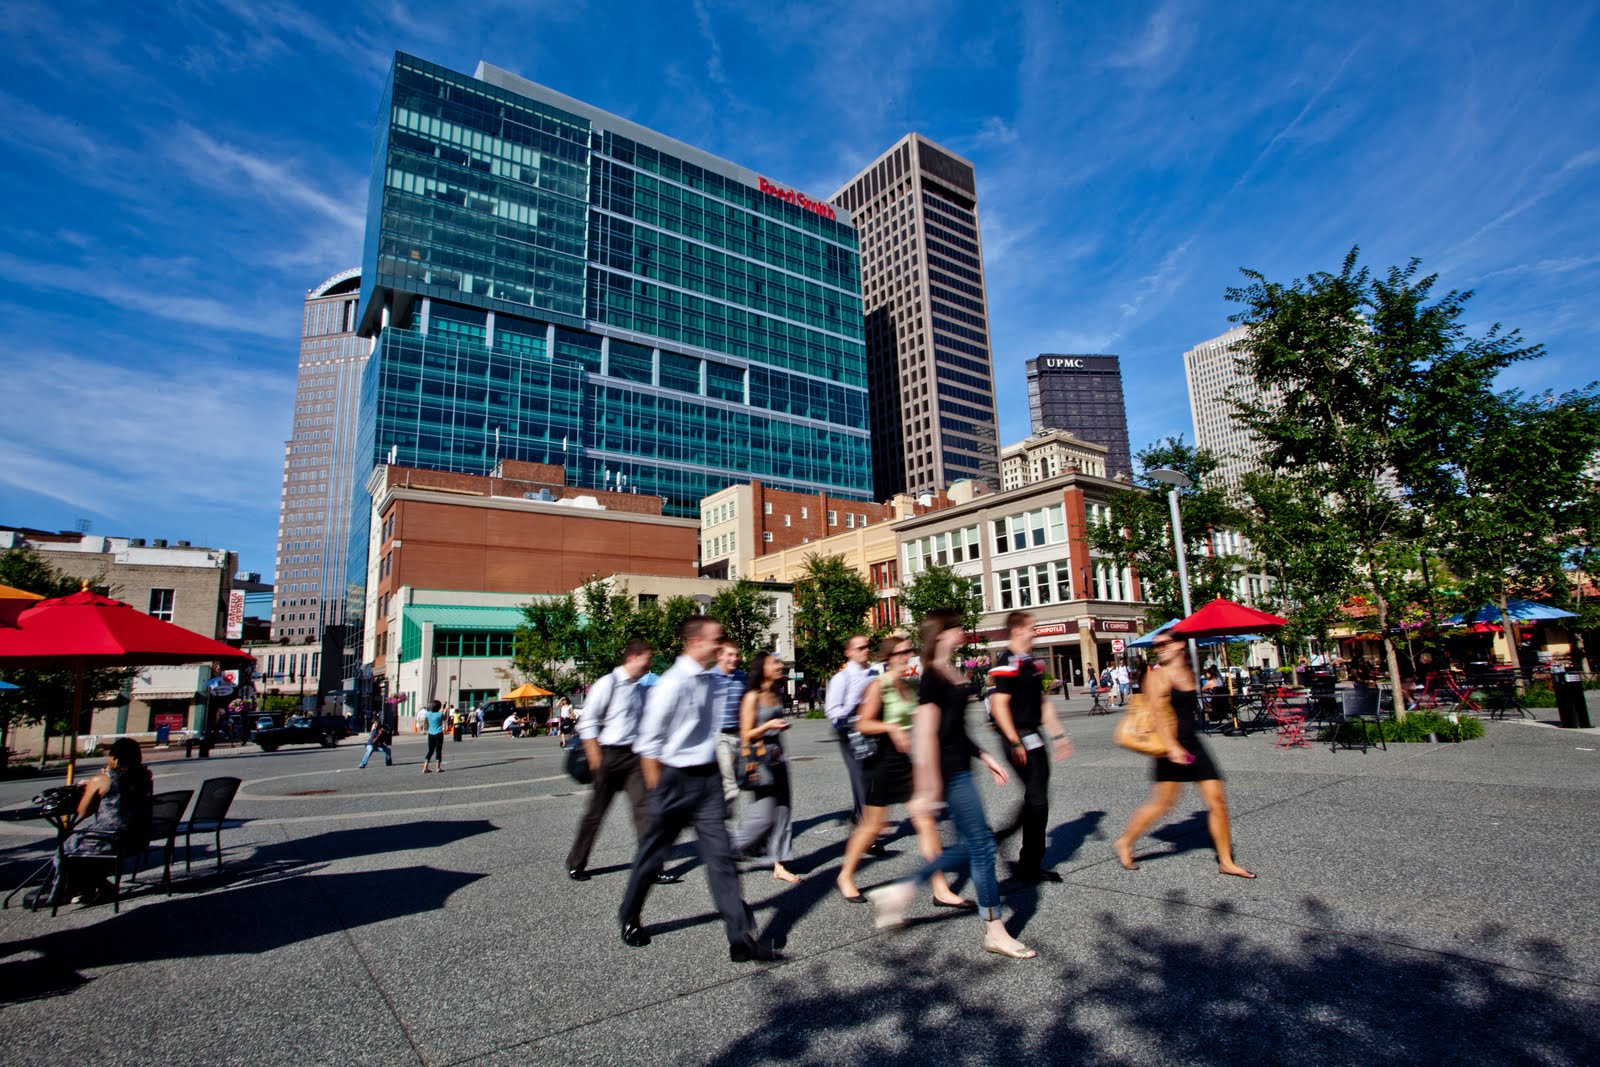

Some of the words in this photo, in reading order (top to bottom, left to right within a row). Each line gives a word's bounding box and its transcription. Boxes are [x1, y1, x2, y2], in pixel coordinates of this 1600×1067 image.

[758, 176, 795, 204] Reed
[796, 192, 835, 220] Smith
[1046, 359, 1084, 368] UPMC
[229, 592, 237, 627] CAMERA
[1036, 625, 1063, 634] CHIPOTLE
